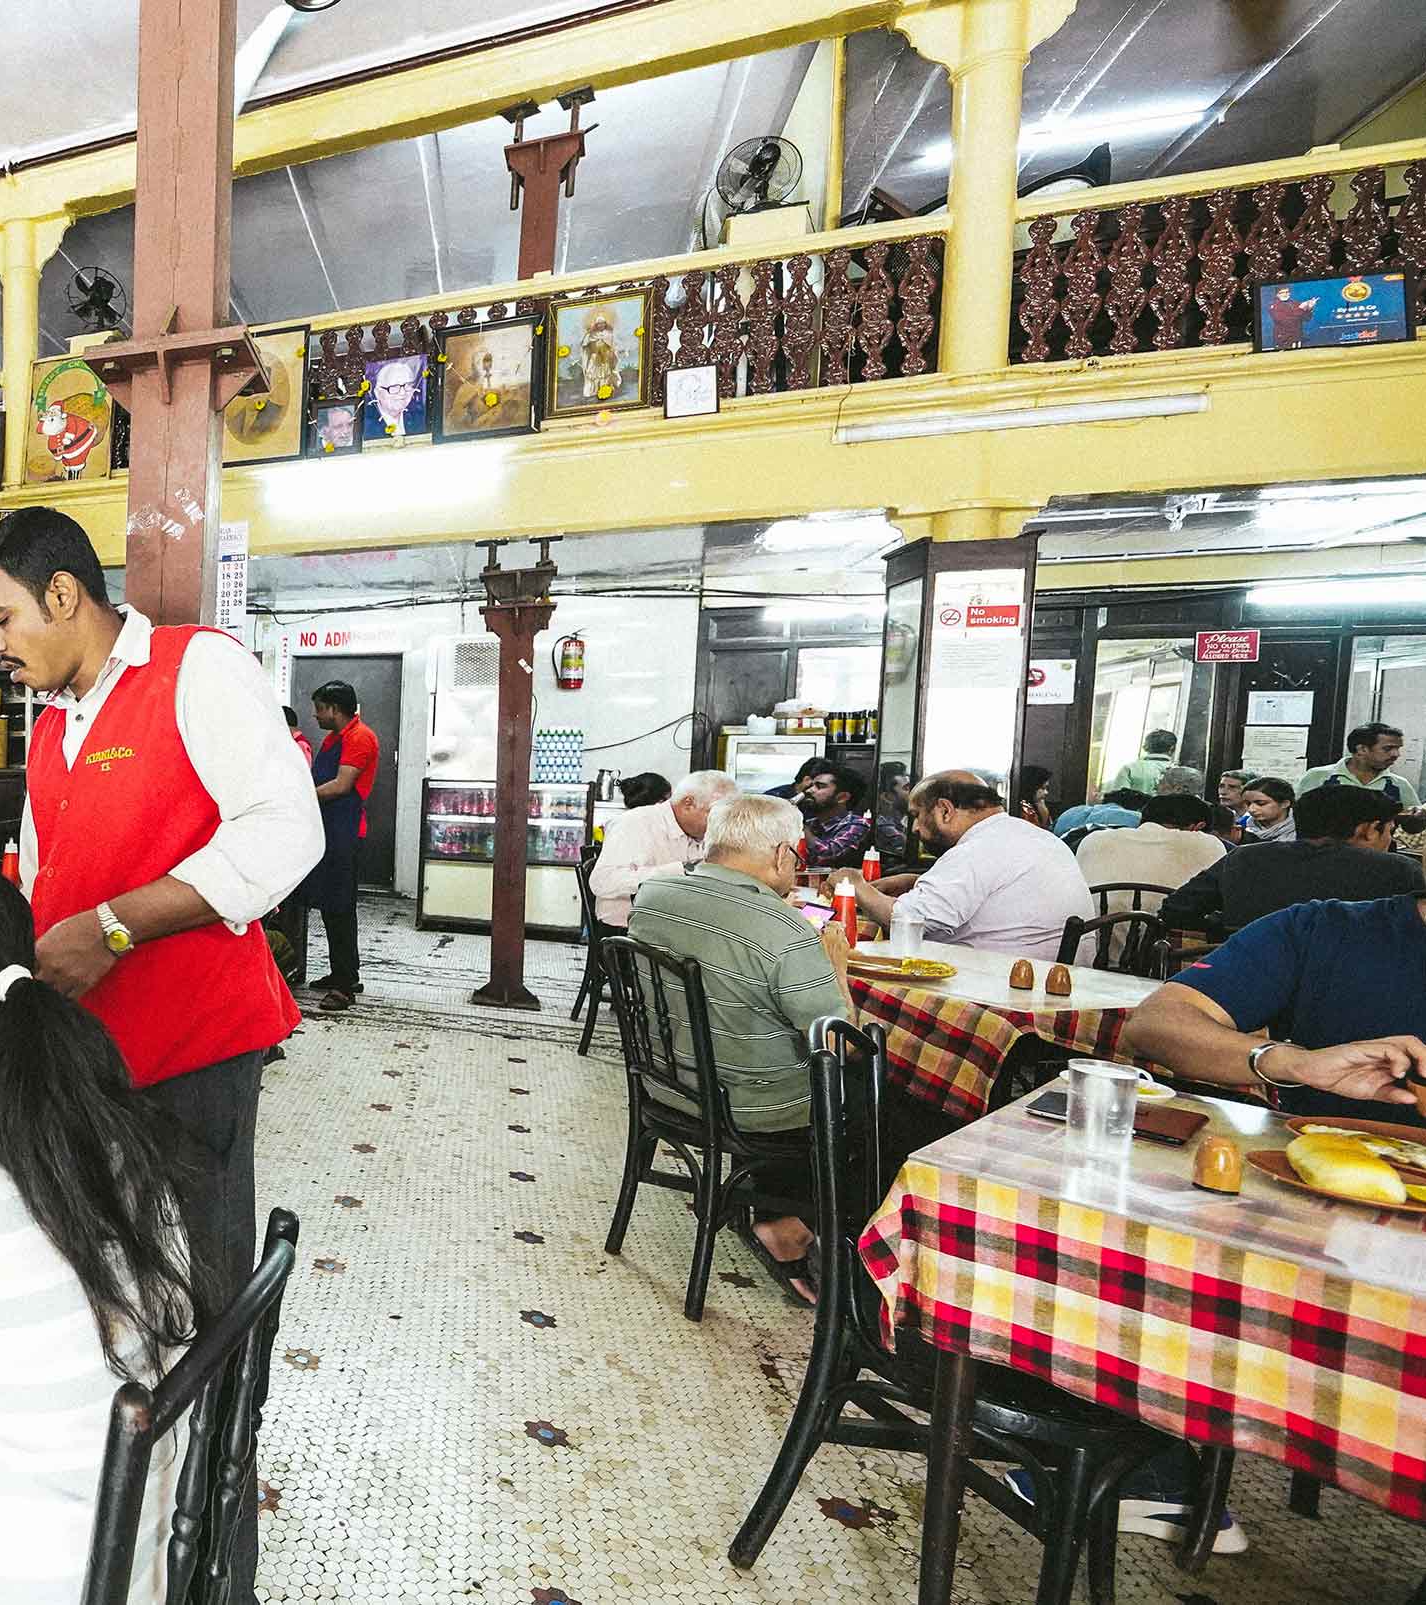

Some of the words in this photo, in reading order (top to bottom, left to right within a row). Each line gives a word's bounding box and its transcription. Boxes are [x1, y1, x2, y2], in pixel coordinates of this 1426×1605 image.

[222, 563, 231, 571] 17
[222, 572, 231, 580] 18
[970, 607, 986, 615] No
[220, 617, 230, 625] 23
[970, 616, 1016, 625] smoking
[300, 632, 318, 647] NO
[1205, 634, 1249, 643] Please
